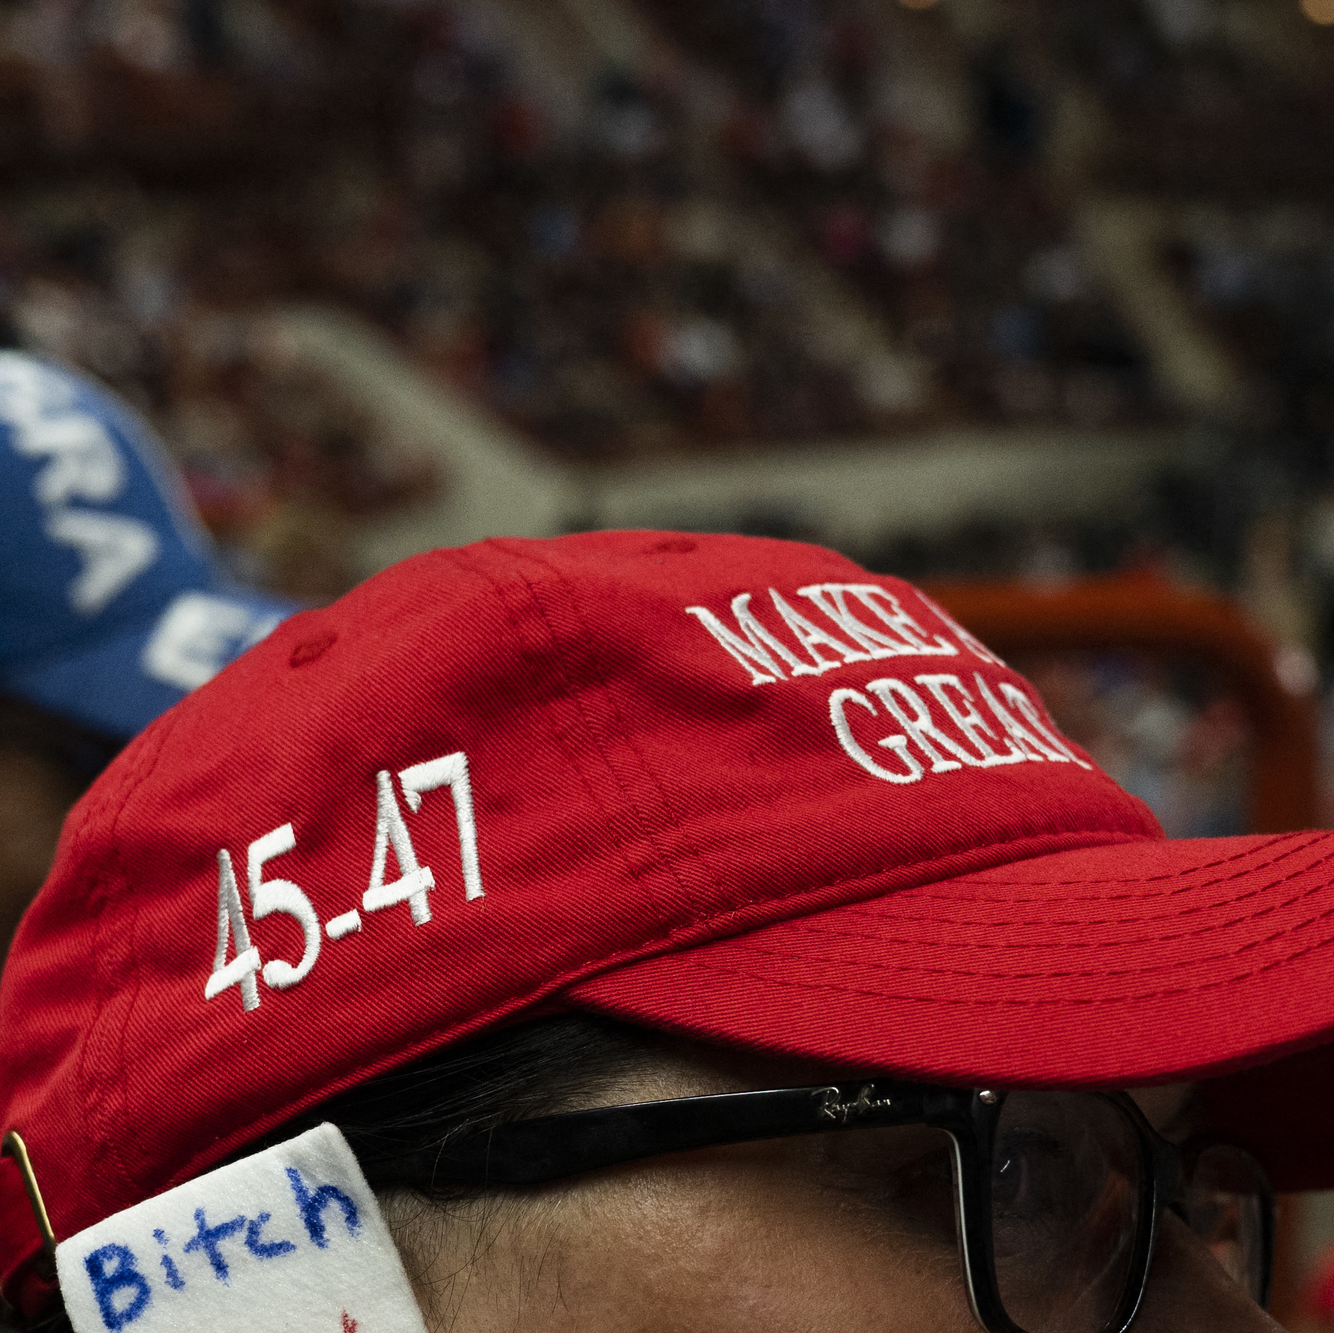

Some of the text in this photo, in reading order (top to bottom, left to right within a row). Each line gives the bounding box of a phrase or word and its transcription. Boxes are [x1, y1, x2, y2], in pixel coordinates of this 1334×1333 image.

[685, 582, 959, 686] MAKE
[828, 672, 1094, 785] GREAT
[204, 750, 486, 1013] 45-47
